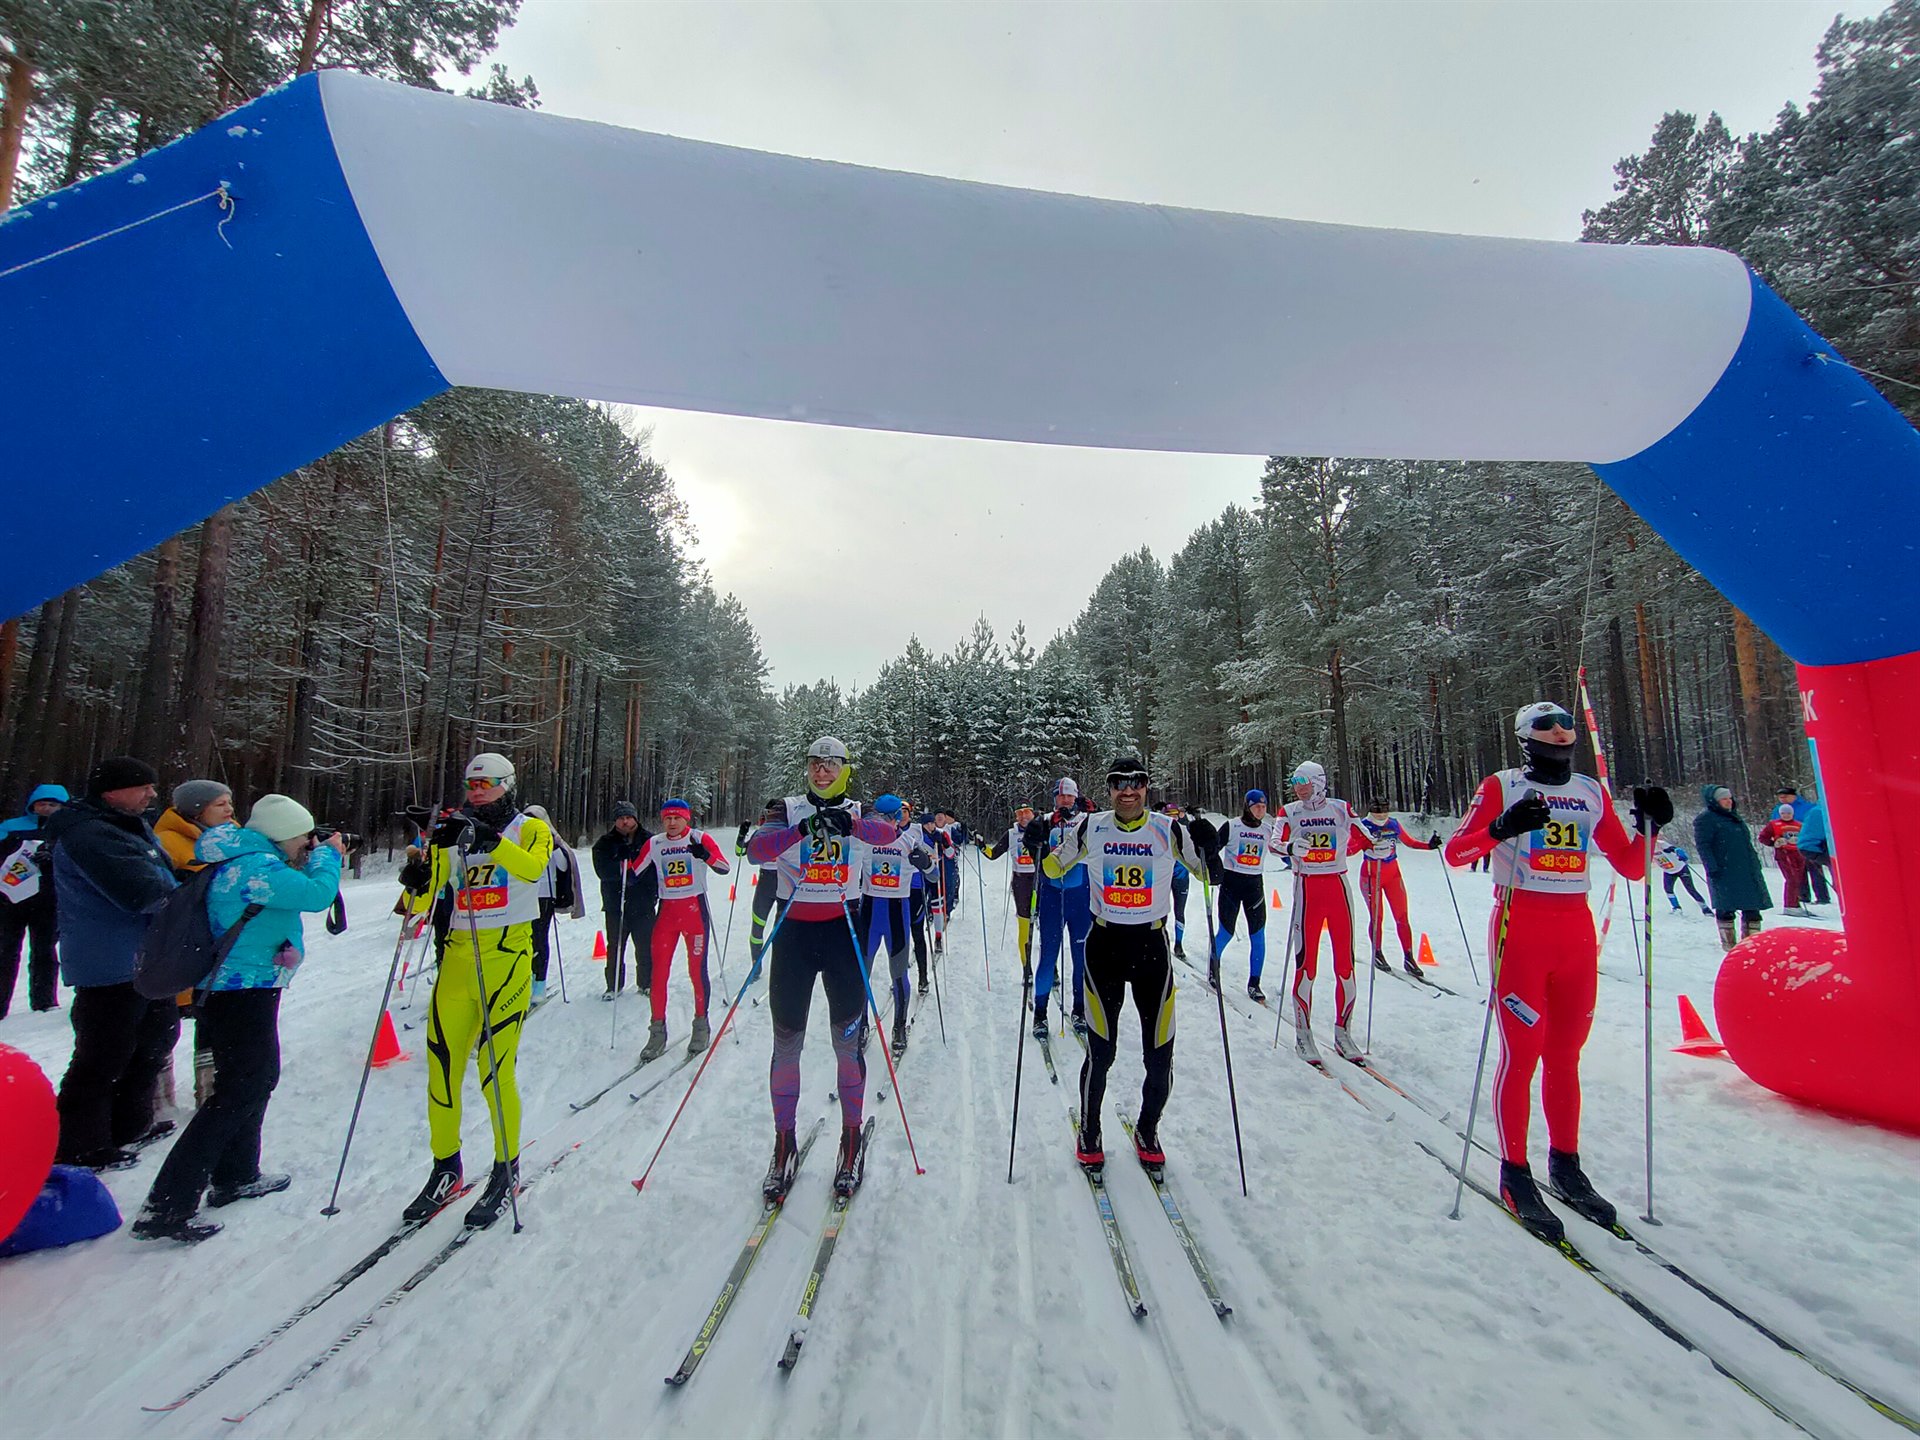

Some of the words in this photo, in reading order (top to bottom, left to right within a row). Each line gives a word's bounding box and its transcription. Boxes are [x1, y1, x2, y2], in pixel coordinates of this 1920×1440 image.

[1541, 795, 1590, 812] ЯНСК
[1299, 817, 1337, 828] САЯНСК
[1310, 833, 1329, 848] 12
[1546, 822, 1577, 847] 31
[812, 840, 840, 862] 20
[872, 846, 902, 857] САЯНСК
[1103, 842, 1154, 857] САЯНСК
[1245, 843, 1259, 855] 14
[667, 860, 686, 875] 25
[881, 861, 890, 875] 3
[467, 864, 496, 888] 27
[1114, 866, 1142, 888] 18
[799, 1271, 820, 1316] FISCHE
[699, 1282, 734, 1338] FISCHER
